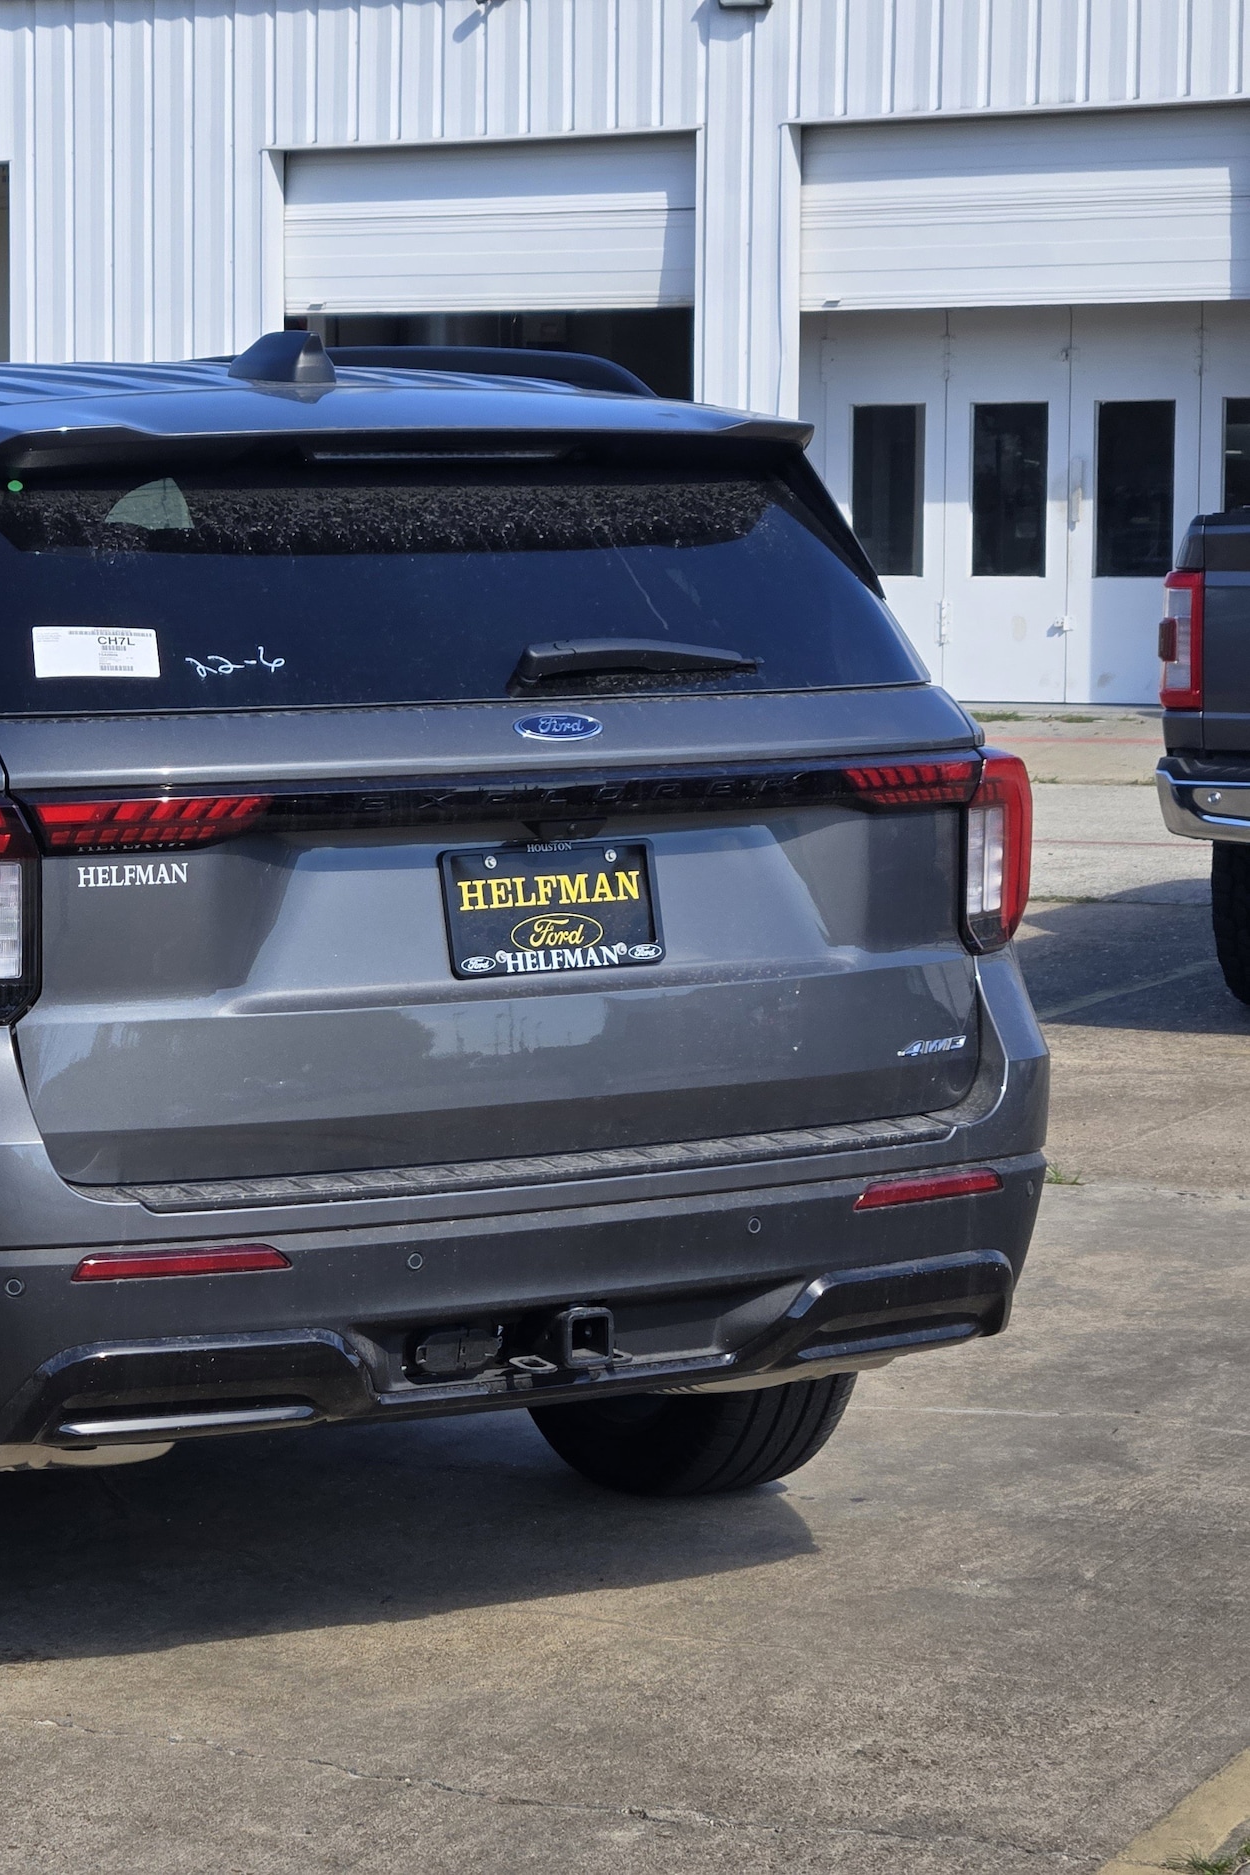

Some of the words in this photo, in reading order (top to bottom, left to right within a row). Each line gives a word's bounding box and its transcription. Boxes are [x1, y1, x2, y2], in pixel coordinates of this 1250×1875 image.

[97, 636, 136, 646] CH7L
[537, 716, 585, 733] Ford
[527, 842, 572, 853] HOUSTON
[77, 863, 189, 888] HELFMAN
[457, 870, 640, 911] HELFMAN
[529, 918, 585, 947] Ford
[506, 945, 619, 973] HELFMAN
